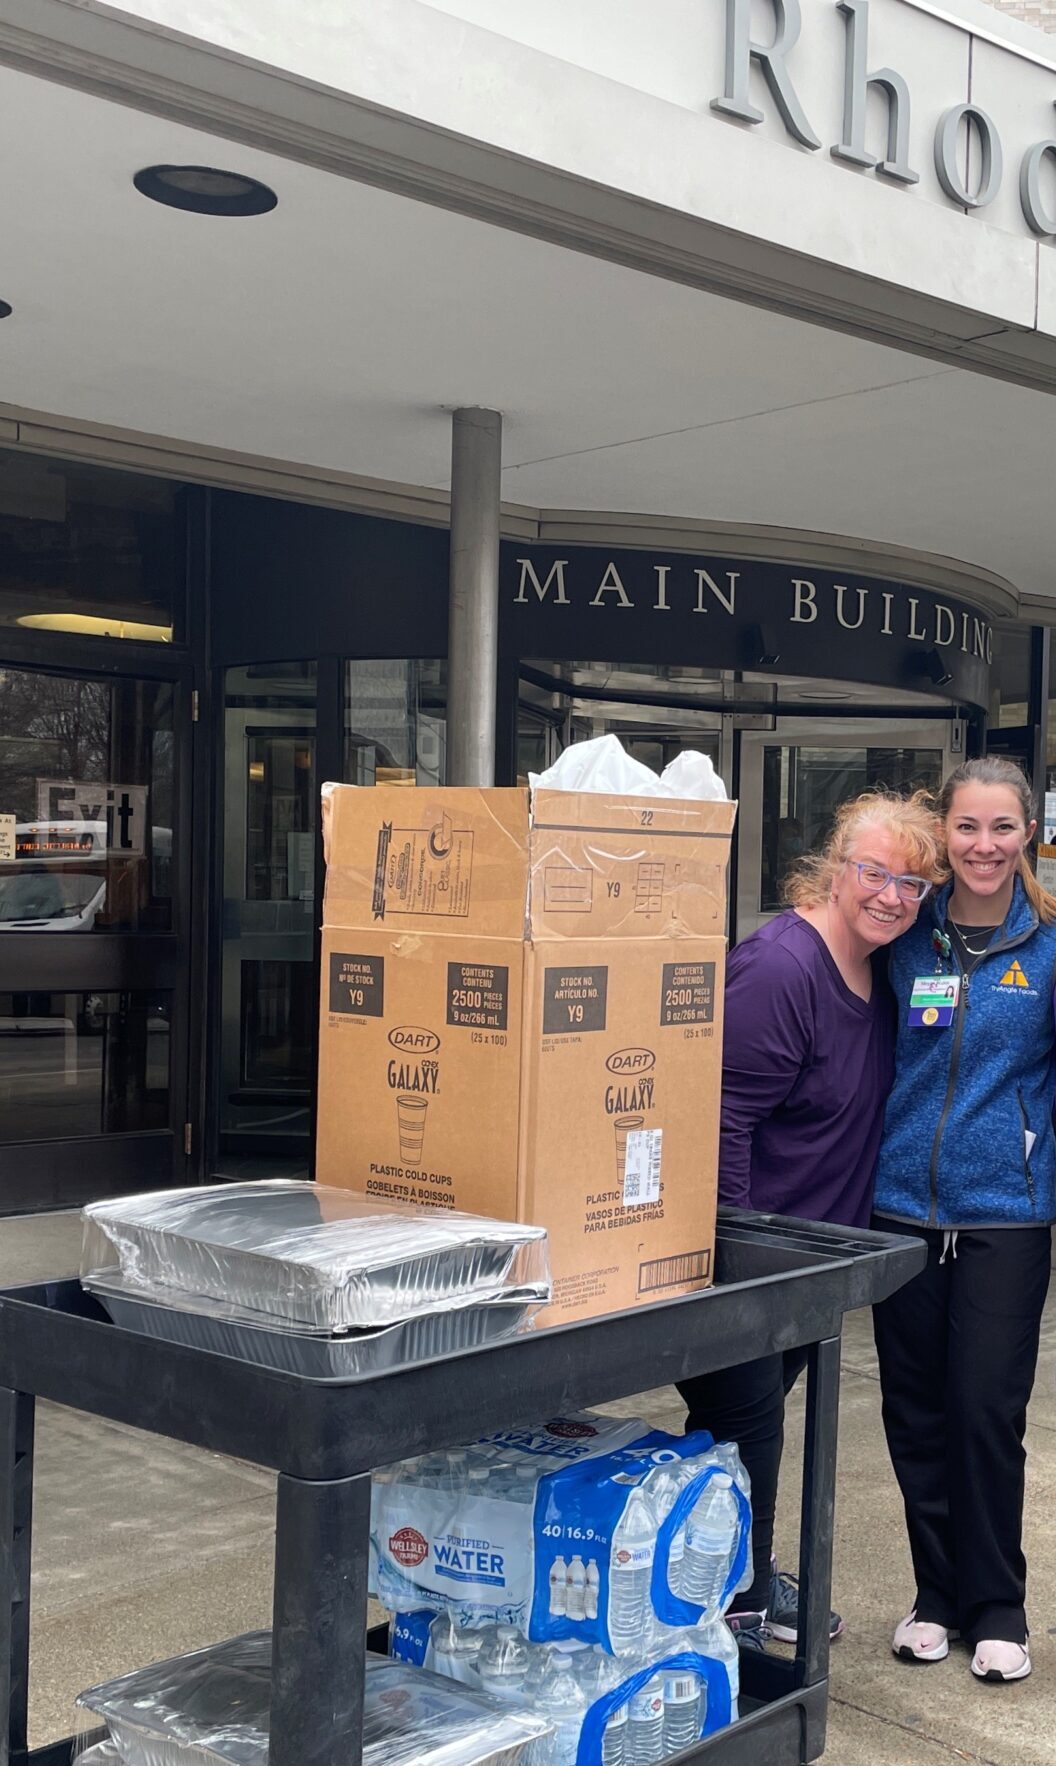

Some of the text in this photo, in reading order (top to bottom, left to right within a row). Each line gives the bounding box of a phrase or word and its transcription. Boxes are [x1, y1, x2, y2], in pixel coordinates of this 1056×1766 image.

[513, 558, 993, 664] MAIN BUILDING
[49, 786, 134, 849] Exit
[641, 810, 653, 826] 22
[606, 882, 621, 898] Y9
[343, 963, 372, 974] STOCK NO.
[461, 967, 494, 978] CONTENTS
[674, 966, 704, 976] CONTENTS
[347, 975, 355, 983] DE
[355, 976, 374, 985] STOCK
[463, 978, 492, 988] CONTENU
[560, 977, 594, 987] STOCK NO.
[672, 975, 705, 985] CONTENIDO
[349, 989, 363, 1006] Y9
[452, 989, 503, 1008] 2500 PIECES
[554, 988, 599, 999] ARTÍCULO NO.
[665, 989, 691, 1006] 2500
[454, 1010, 459, 1021] 9
[487, 1015, 499, 1026] mL
[568, 1005, 584, 1022] Y9
[666, 1010, 671, 1021] 9
[394, 1032, 434, 1047] DART
[471, 1032, 508, 1047] (25 x 100)
[683, 1029, 694, 1039] (25
[700, 1027, 714, 1038] 100)
[612, 1054, 650, 1069] DART
[388, 1060, 439, 1094] GALAXY
[605, 1084, 654, 1114] GALAXY
[370, 1163, 452, 1186] PLASTIC COLD CUPS
[366, 1180, 409, 1195] GOBELETS
[410, 1185, 417, 1196] À
[418, 1189, 455, 1203] BOISSON
[586, 1190, 620, 1205] PLASTIC
[584, 1209, 664, 1233] PARA BEBIDAS FRÍAS
[585, 1209, 613, 1221] VASOS
[614, 1206, 625, 1217] DE
[552, 1274, 580, 1286] ONTAINER
[542, 1525, 561, 1538] 40
[567, 1526, 594, 1541] 16.9
[390, 1540, 428, 1554] WELLSLEY
[446, 1535, 490, 1550] PURIFIED
[434, 1544, 504, 1575] WATER
